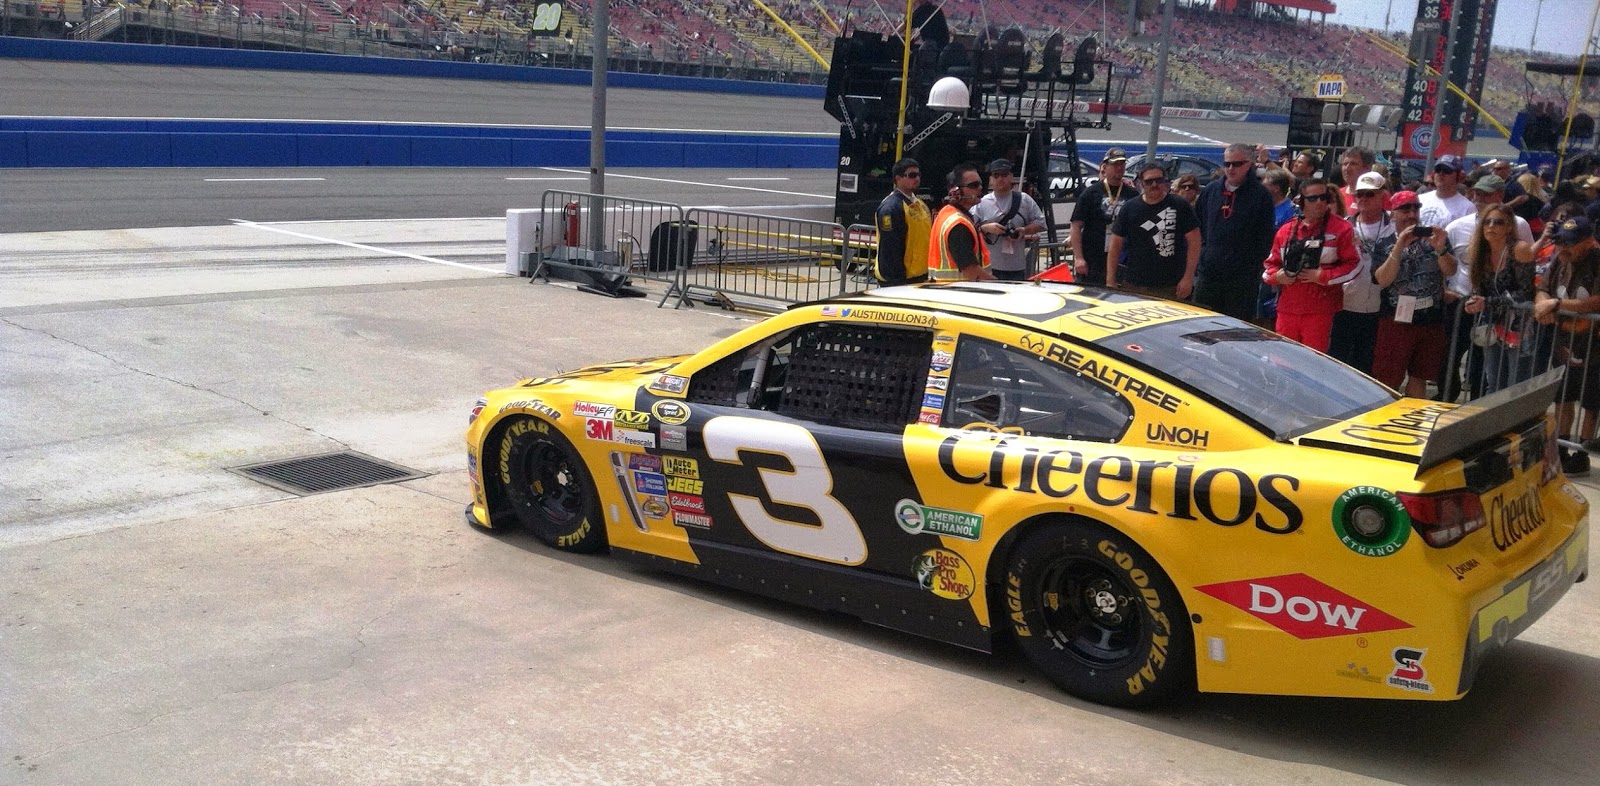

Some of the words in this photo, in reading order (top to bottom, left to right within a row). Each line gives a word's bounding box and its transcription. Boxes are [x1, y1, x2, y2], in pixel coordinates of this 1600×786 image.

[533, 3, 562, 30] 20
[1424, 6, 1439, 18] 35
[1319, 82, 1342, 96] NAPA
[1413, 80, 1428, 92] 40
[1410, 95, 1423, 106] 41
[1408, 109, 1422, 121] 42
[840, 156, 851, 166] 20
[850, 309, 928, 324] AUSTINDILLON3
[1047, 342, 1182, 414] REALTREE
[574, 402, 599, 416] Holley
[586, 418, 613, 441] 3M
[1146, 421, 1209, 447] UNOH
[500, 418, 550, 485] GOODYEAR
[673, 458, 692, 467] Auto
[673, 466, 697, 476] Meter
[667, 476, 704, 495] JEGS
[703, 416, 868, 566] 3
[937, 432, 1304, 535] Cheerios
[671, 495, 704, 511] Edelbrock
[1341, 486, 1406, 512] AMERICAN
[674, 512, 711, 527] FLOWMASTER
[926, 511, 978, 528] AMERICAN
[557, 516, 592, 547] EAGLE
[929, 520, 975, 537] ETHANOL
[1341, 535, 1402, 556] ETHANOL
[935, 550, 960, 569] Bass
[937, 564, 957, 580] Pro
[939, 576, 970, 598] Shops
[1007, 571, 1033, 637] EAGLE
[1097, 539, 1171, 696] GOODYEAR
[1389, 676, 1430, 691] safety-kleen
